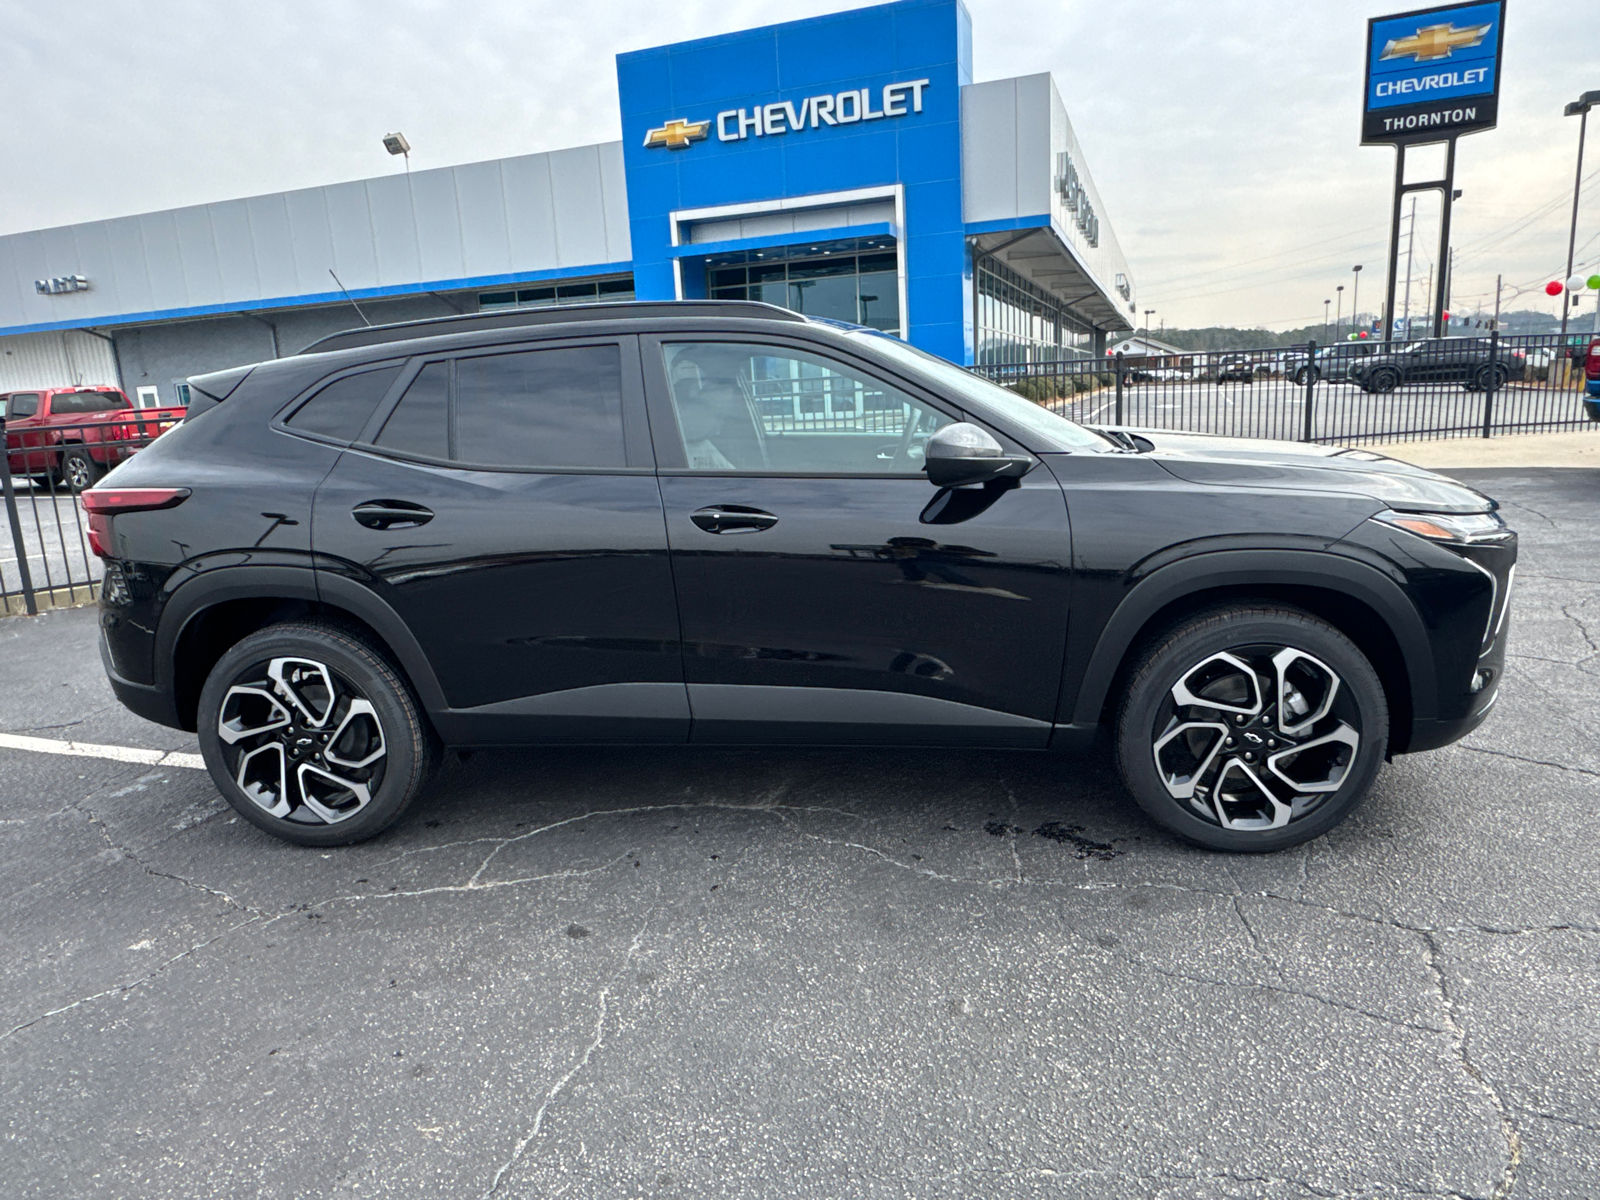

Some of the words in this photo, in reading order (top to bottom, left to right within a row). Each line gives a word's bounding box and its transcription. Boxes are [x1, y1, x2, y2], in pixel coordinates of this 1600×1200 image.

[1376, 67, 1489, 97] CHEVROLET
[716, 78, 930, 142] CHEVROLET
[1383, 107, 1477, 131] THORNTON
